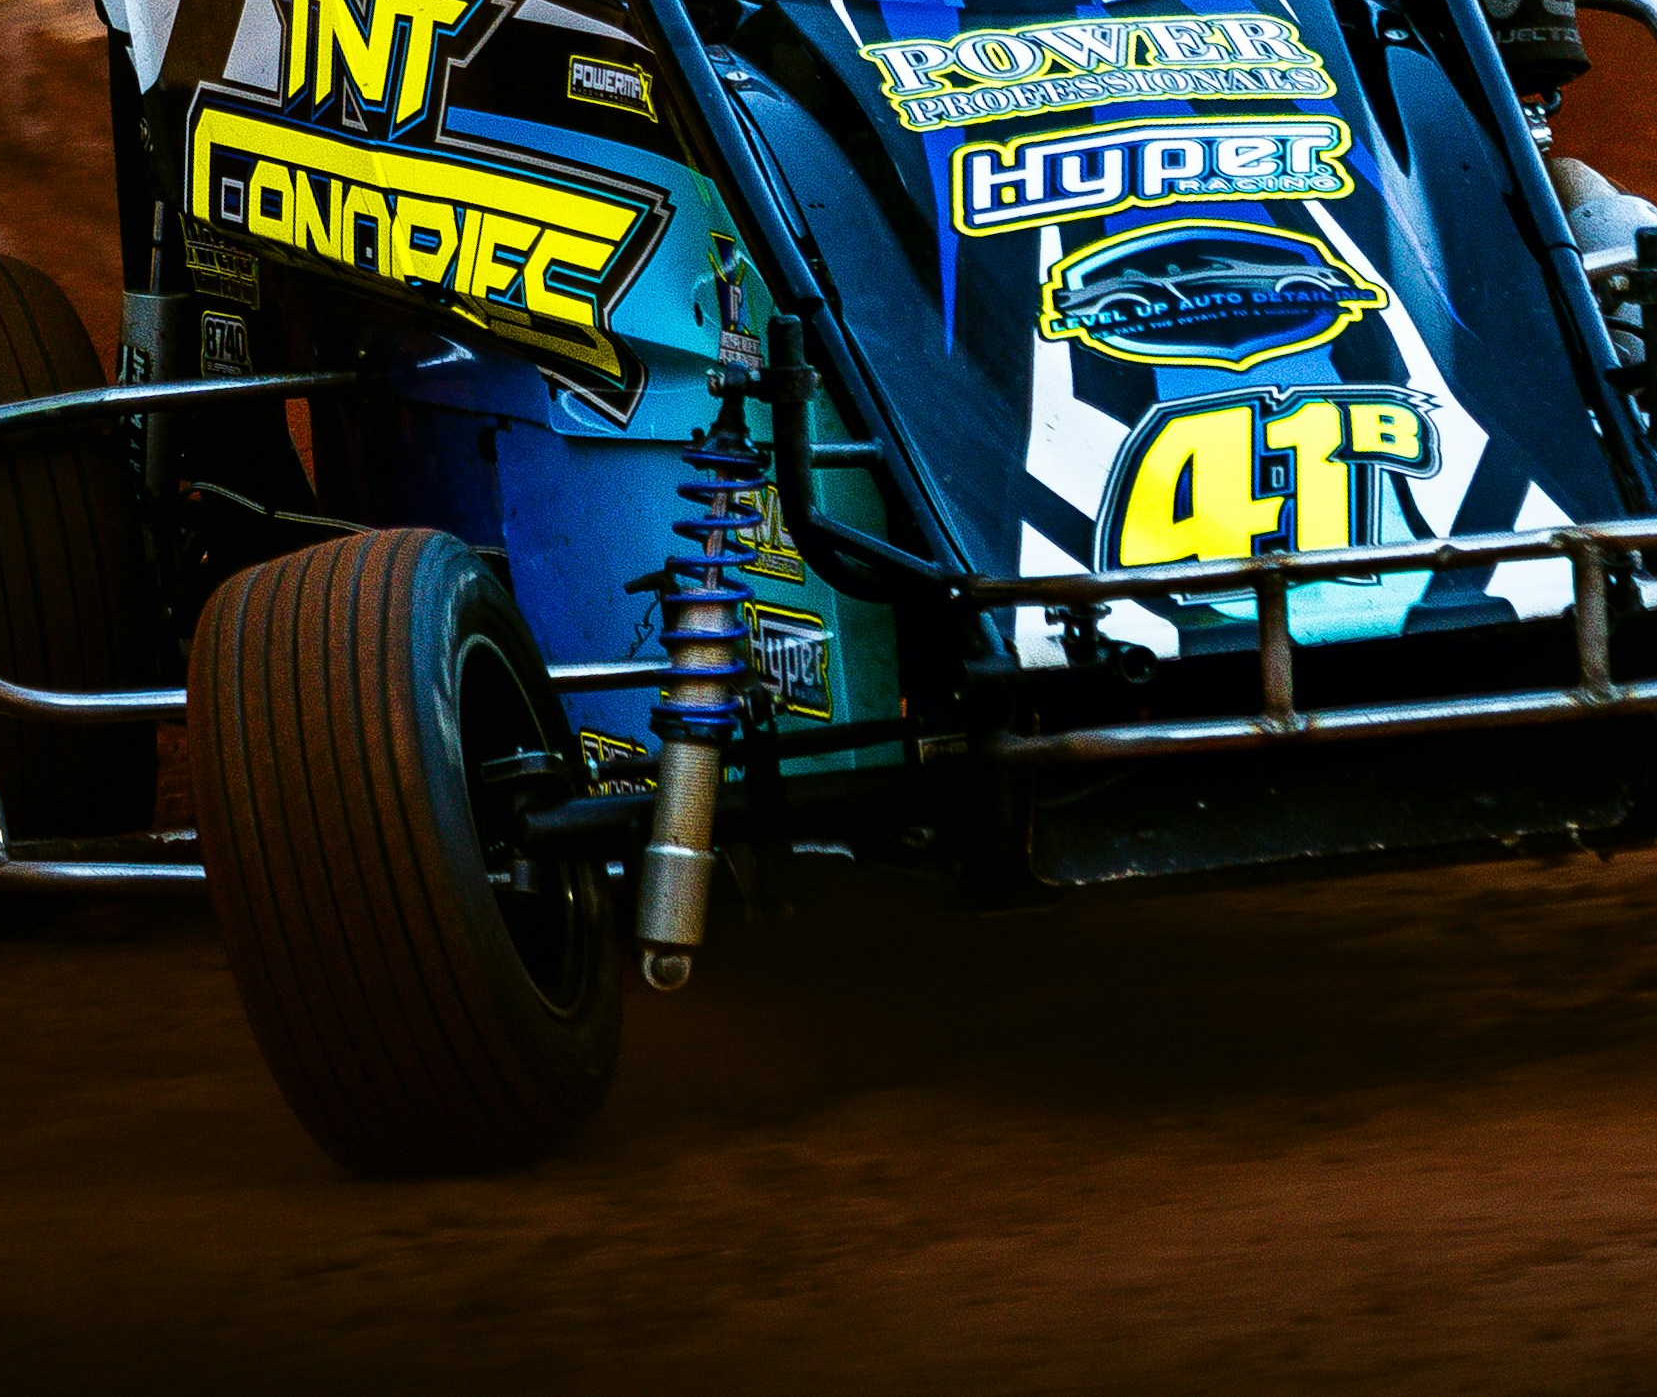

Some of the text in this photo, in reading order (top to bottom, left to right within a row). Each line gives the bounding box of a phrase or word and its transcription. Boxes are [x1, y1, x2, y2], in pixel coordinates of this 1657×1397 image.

[878, 17, 1319, 96] POWER
[898, 66, 1328, 126] PROFESSIONALS
[971, 125, 1336, 217] Hyper
[1176, 175, 1342, 194] RACING
[204, 318, 246, 364] 8740
[1050, 308, 1126, 332] LEVEL
[1136, 301, 1169, 319] UP
[1179, 291, 1243, 310] AUTO
[748, 615, 833, 699] Hyper
